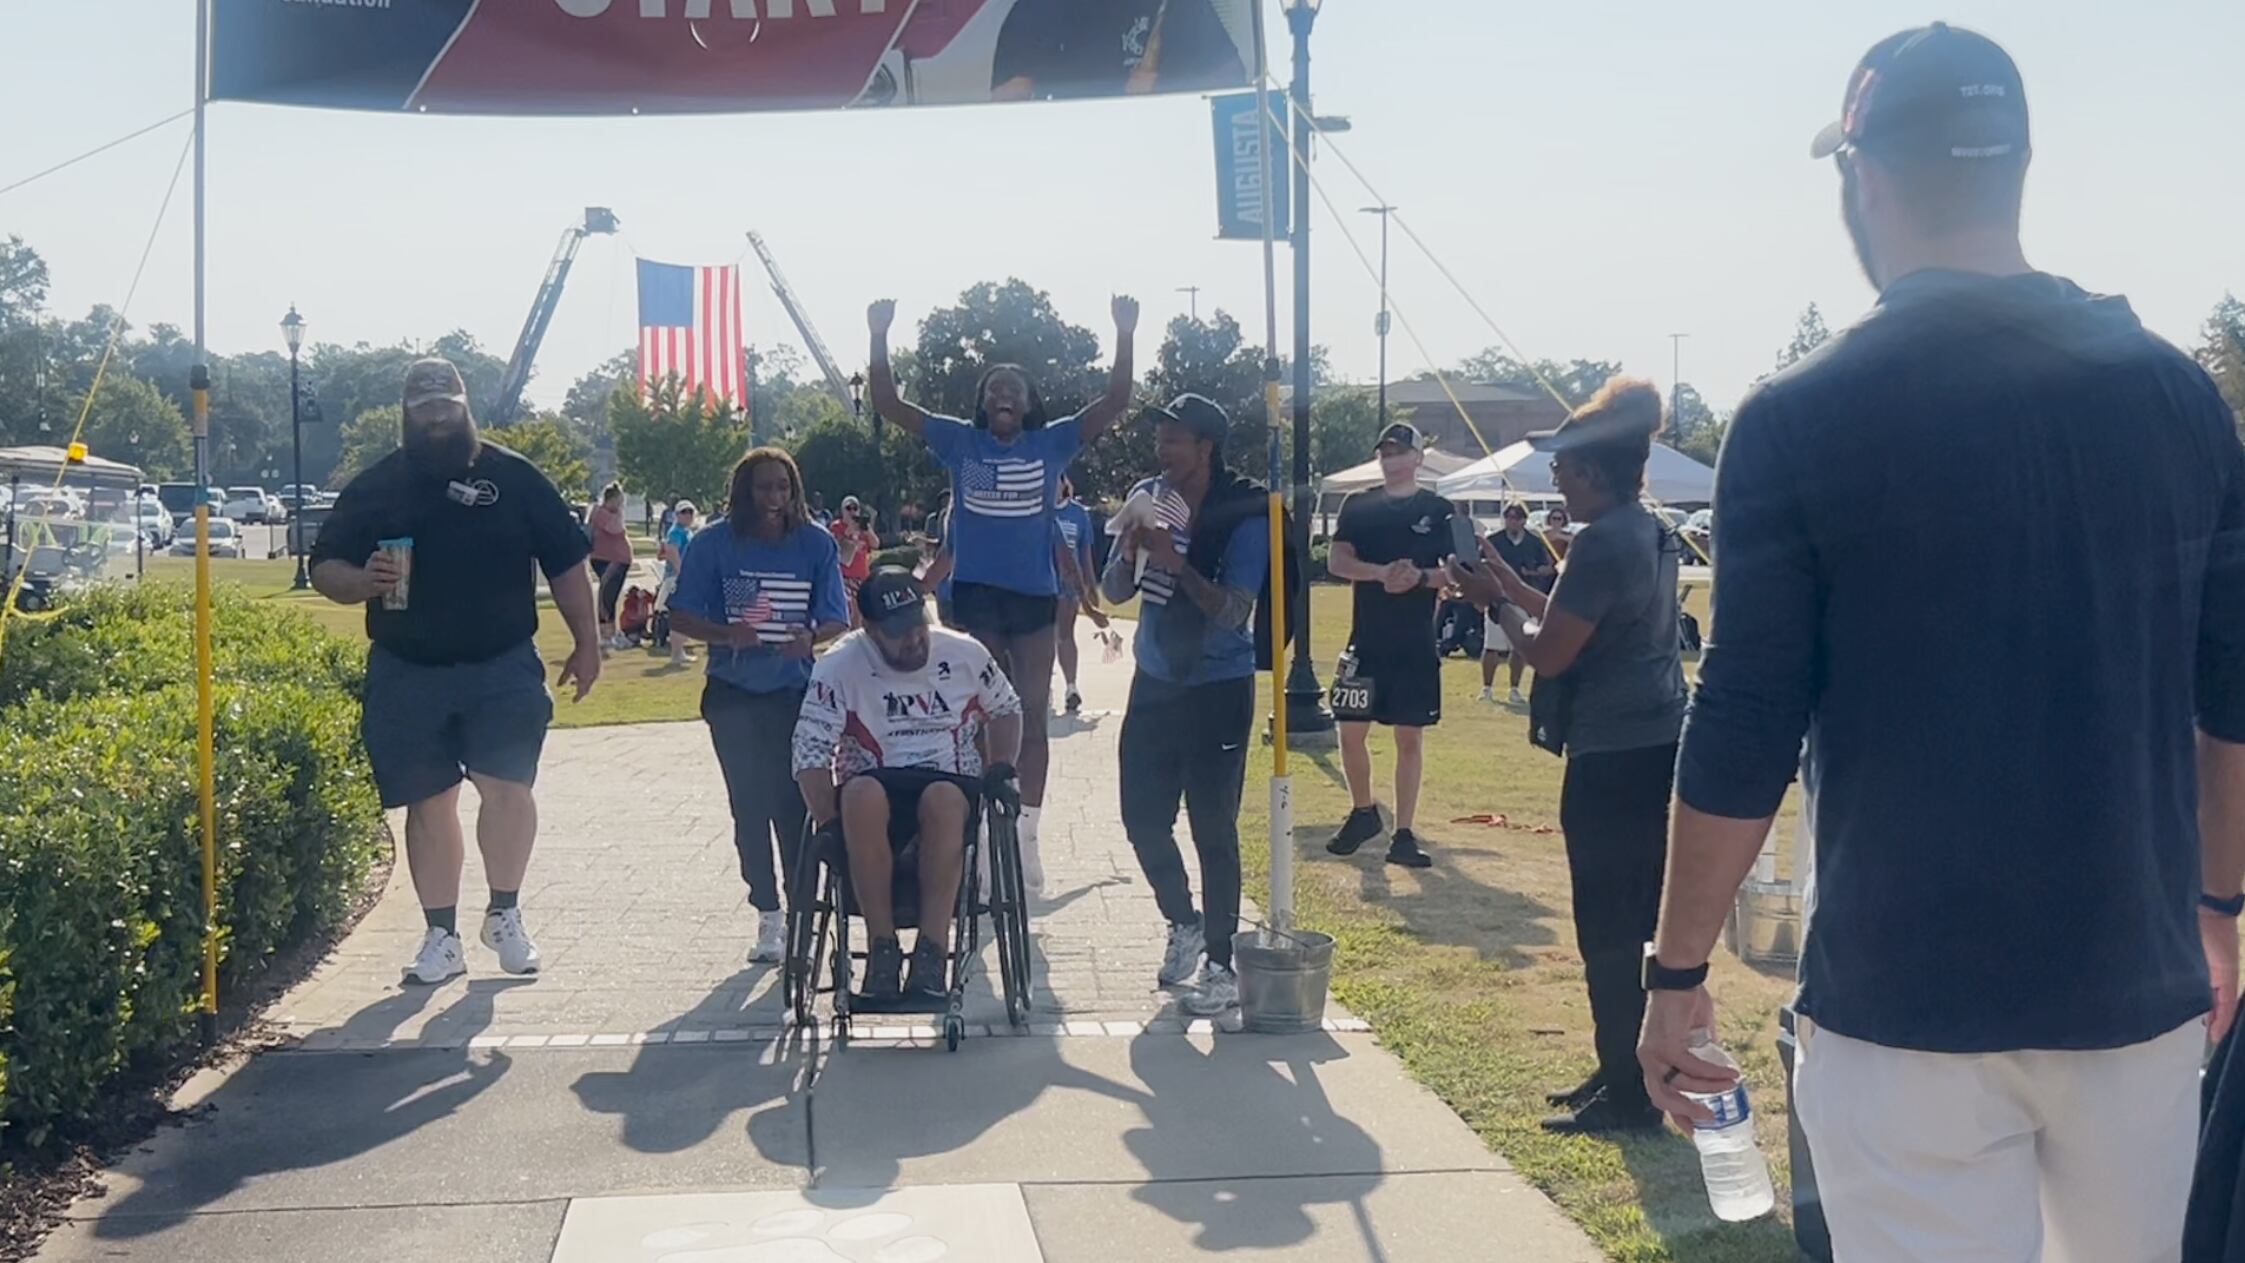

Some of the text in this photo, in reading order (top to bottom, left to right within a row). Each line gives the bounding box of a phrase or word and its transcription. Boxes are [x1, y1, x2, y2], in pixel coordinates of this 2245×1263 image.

[1231, 109, 1263, 224] AUGUSTA
[898, 689, 950, 716] PVA
[1331, 687, 1368, 708] 2703
